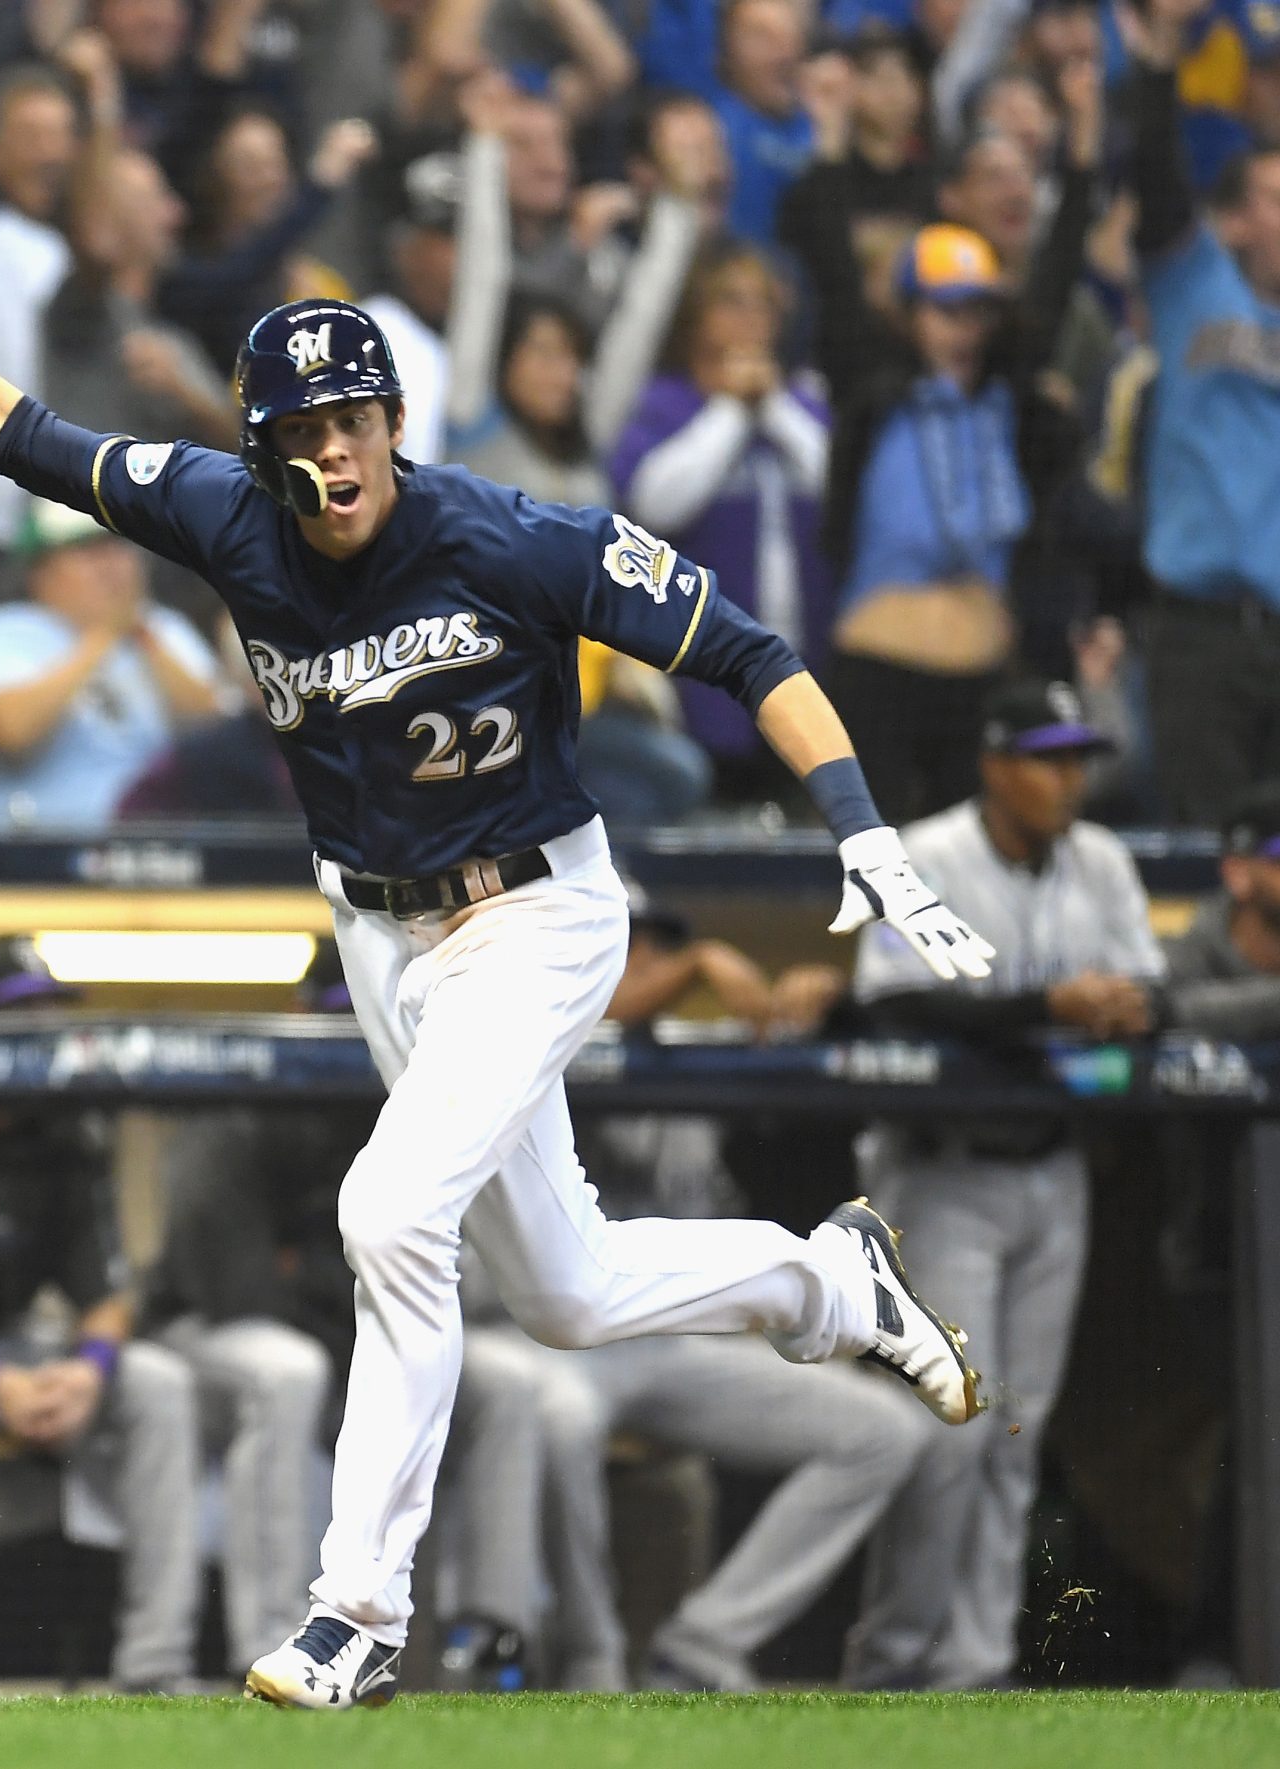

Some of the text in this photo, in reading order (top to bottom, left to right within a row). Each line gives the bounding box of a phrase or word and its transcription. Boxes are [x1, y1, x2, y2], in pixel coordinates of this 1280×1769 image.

[287, 323, 332, 375] M
[247, 612, 504, 733] Brewers
[405, 704, 522, 782] 22
